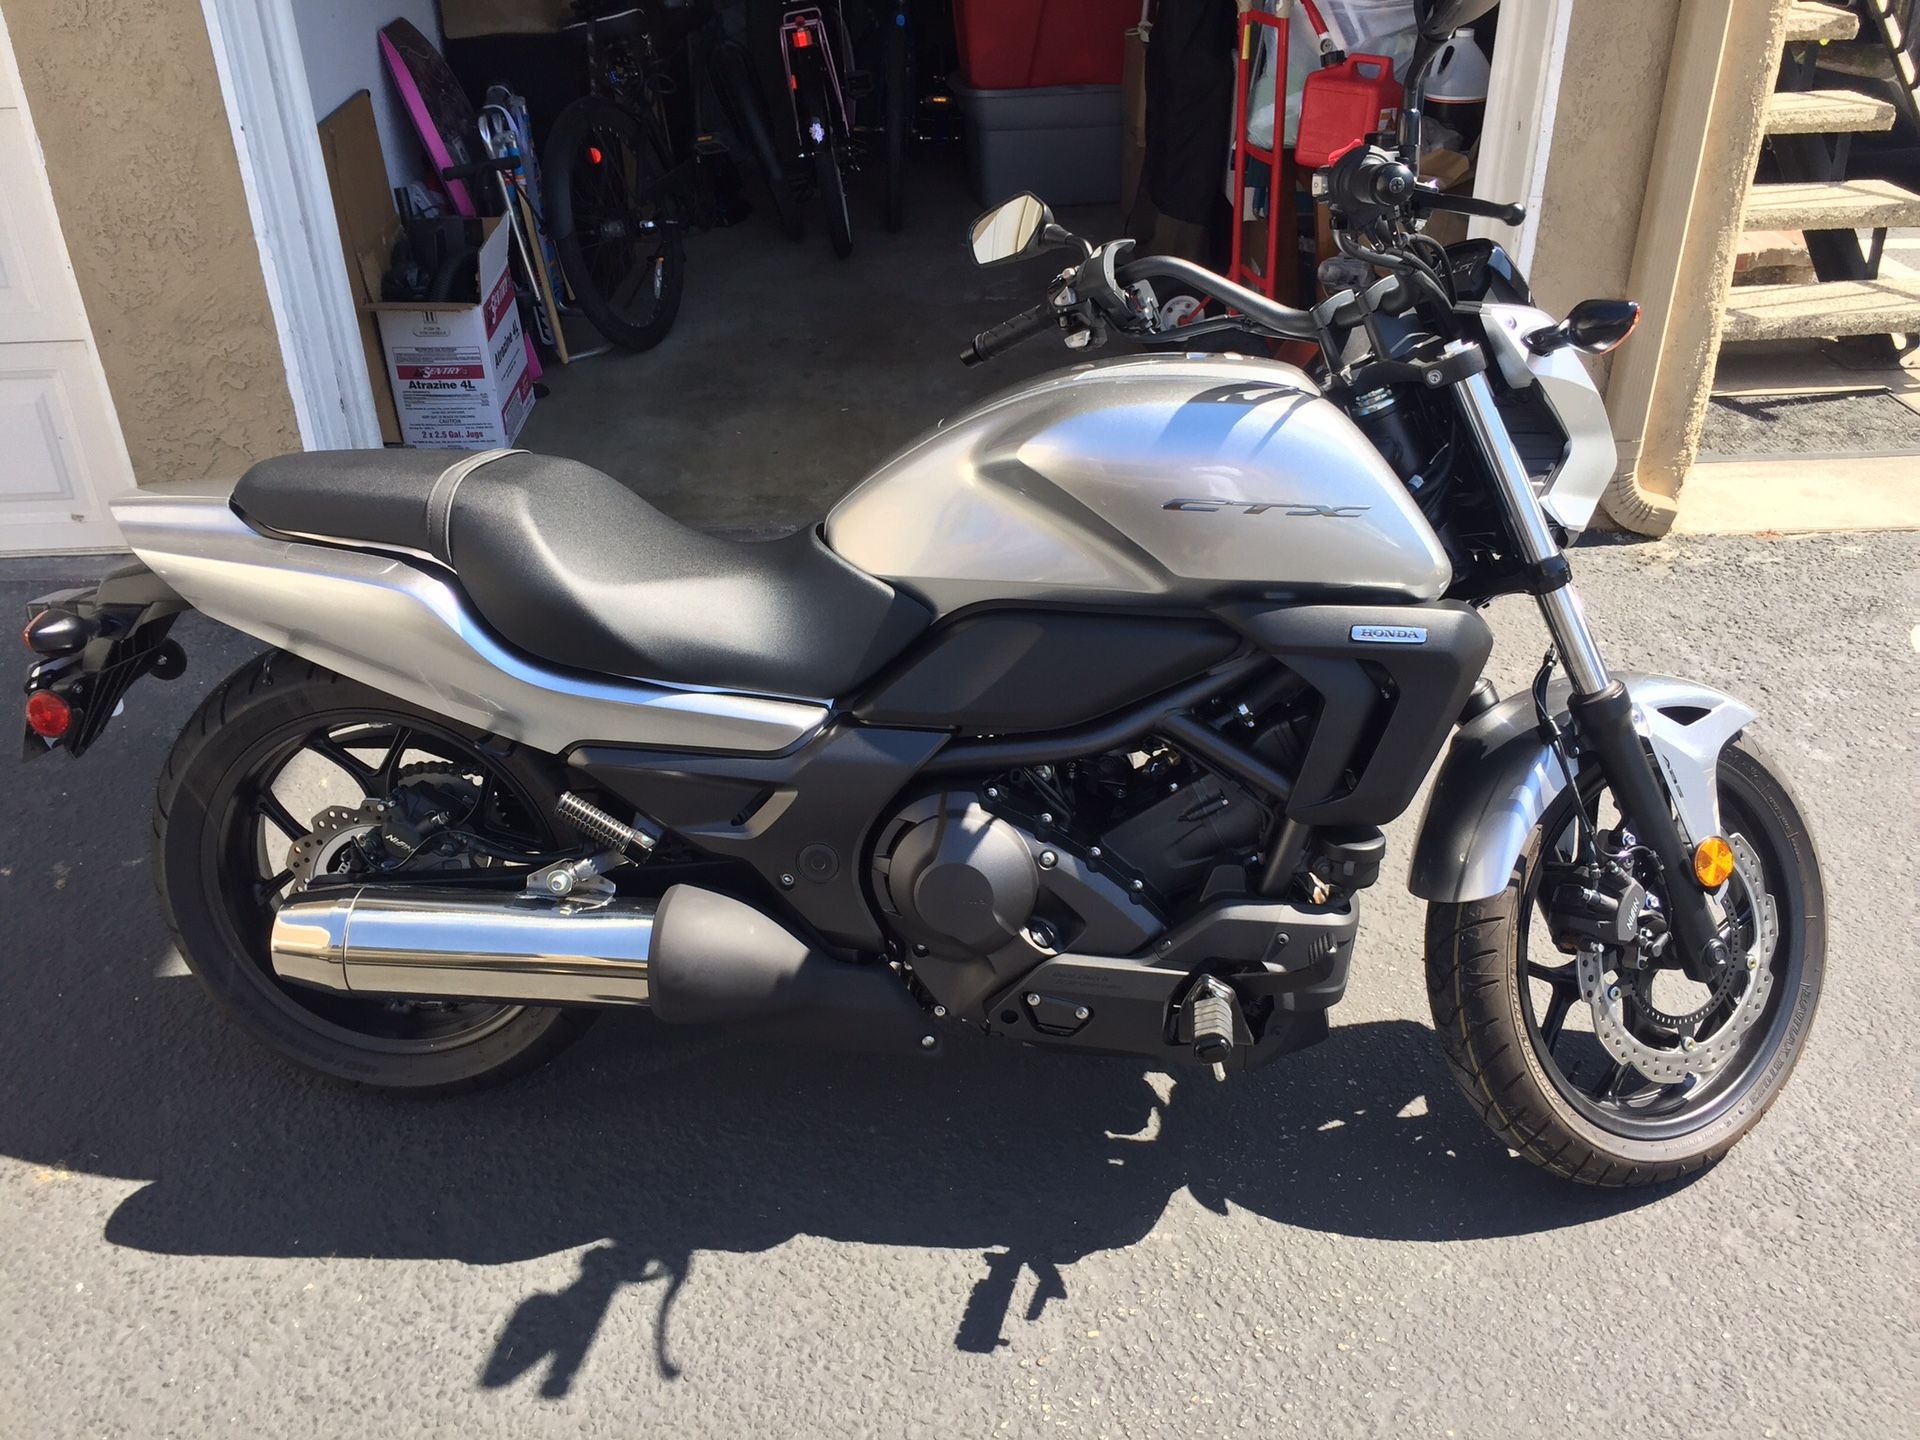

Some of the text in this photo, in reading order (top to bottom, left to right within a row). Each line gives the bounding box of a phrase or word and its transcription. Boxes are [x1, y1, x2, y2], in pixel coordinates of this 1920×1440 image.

[423, 366, 462, 378] SENTRY
[409, 380, 475, 390] Atrazine 4L
[449, 430, 464, 438] Gal.
[466, 430, 484, 438] Jugs
[1161, 498, 1372, 518] CTX
[1360, 628, 1419, 639] HONDA
